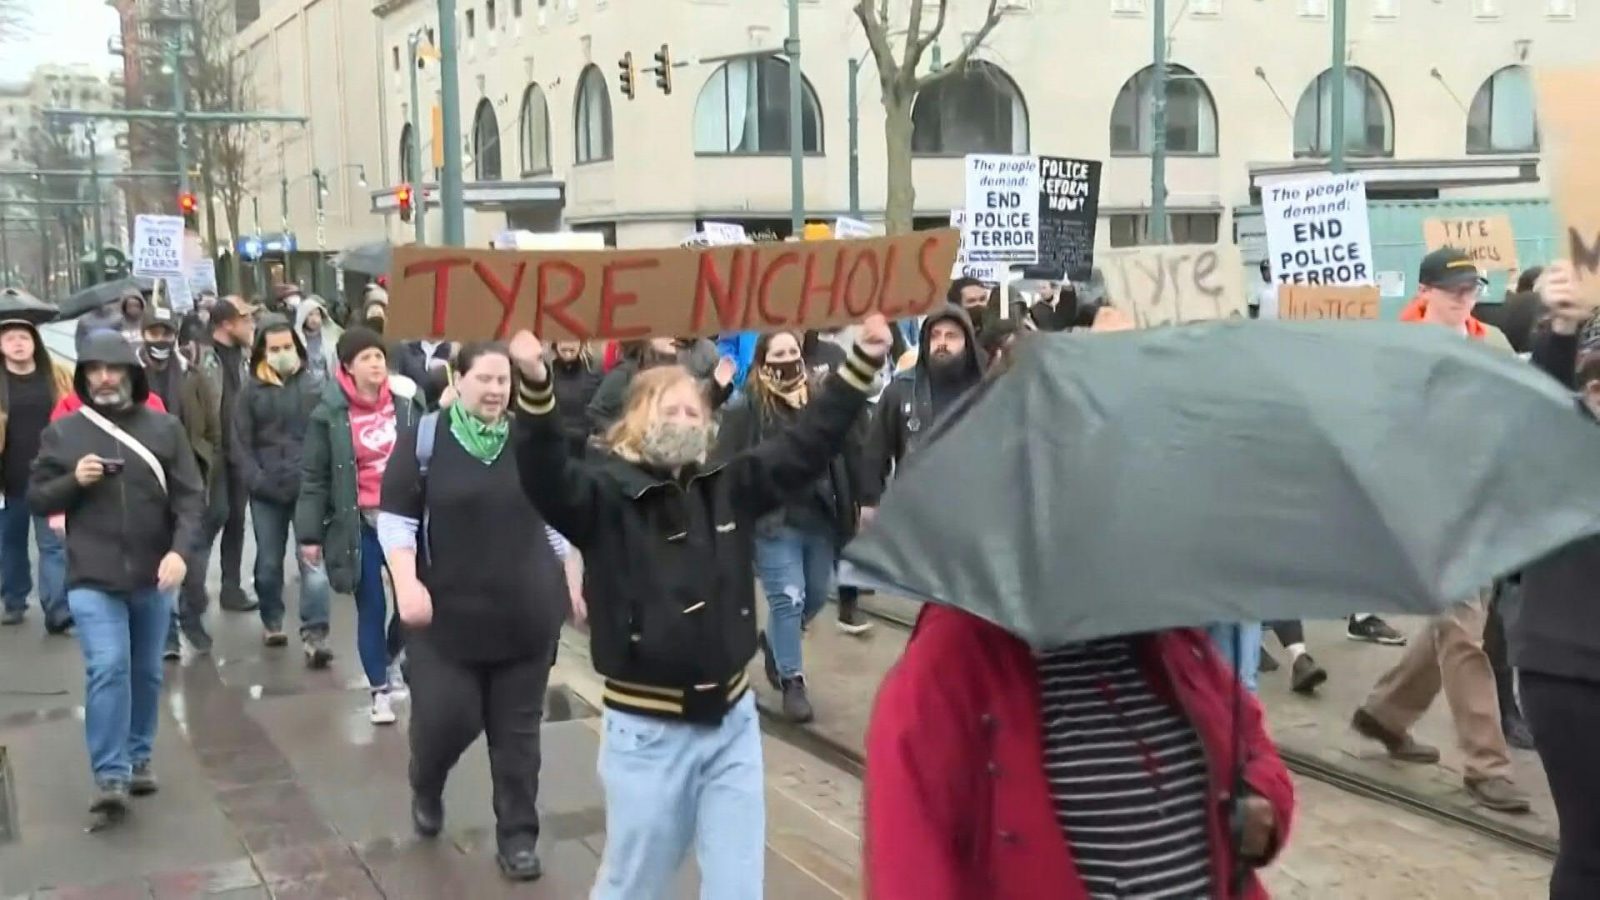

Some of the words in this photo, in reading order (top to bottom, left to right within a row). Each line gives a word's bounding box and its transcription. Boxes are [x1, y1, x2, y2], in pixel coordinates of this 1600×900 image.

[1042, 159, 1089, 180] POLICE
[986, 191, 1021, 209] END
[1305, 180, 1360, 201] people
[975, 212, 1031, 228] POLICE
[148, 236, 172, 247] END
[970, 230, 1034, 247] TERROR
[1293, 219, 1343, 243] END
[1281, 242, 1360, 270] POLICE
[404, 258, 660, 342] TYRE
[689, 236, 939, 334] NICHOLS
